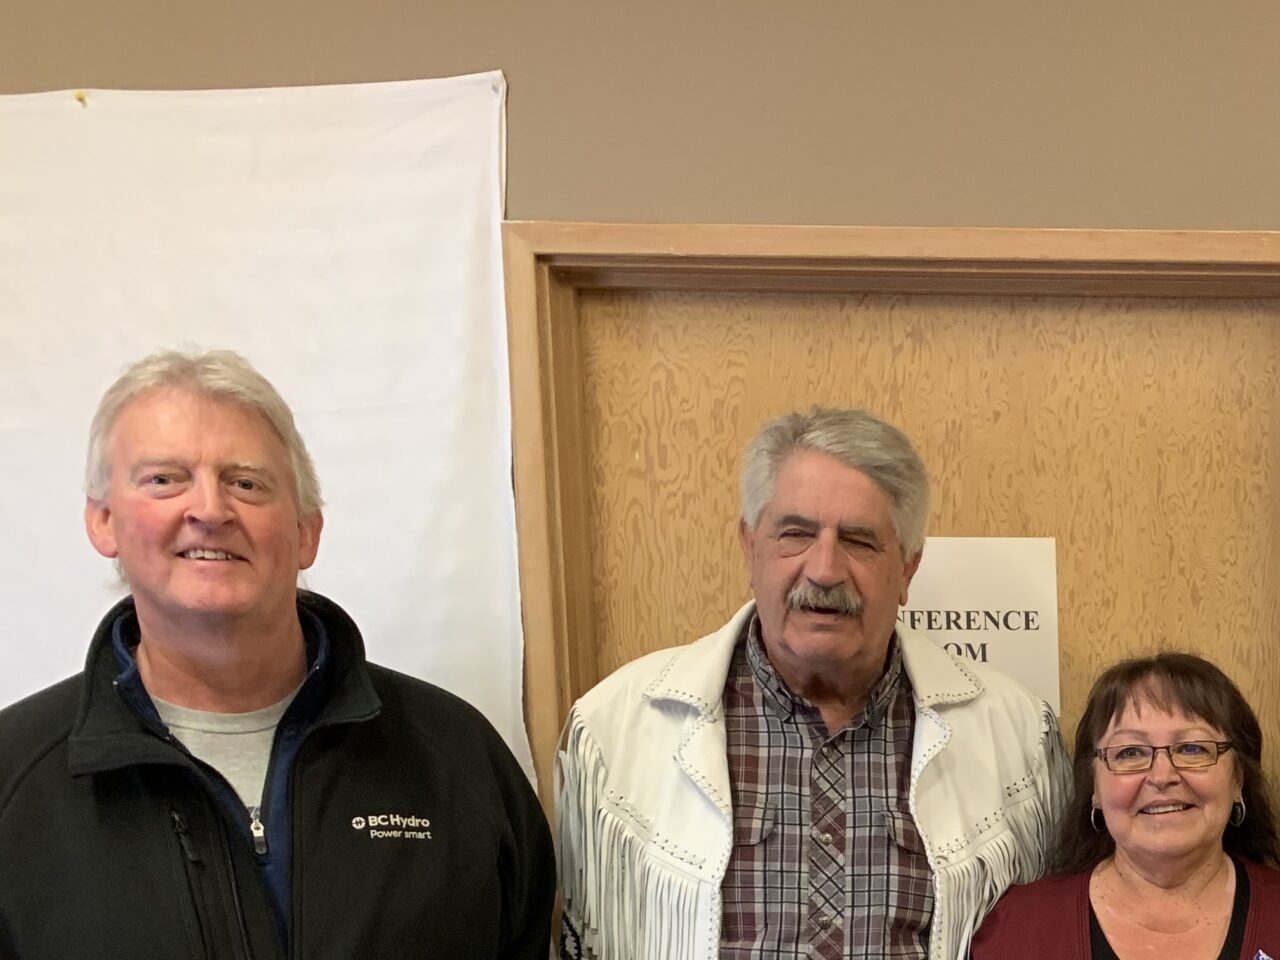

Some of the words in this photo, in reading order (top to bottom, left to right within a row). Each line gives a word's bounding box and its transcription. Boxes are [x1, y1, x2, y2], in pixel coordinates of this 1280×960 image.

[368, 815, 389, 826] BC
[389, 814, 430, 828] Hydro
[370, 829, 402, 839] Power
[404, 831, 432, 839] smart
